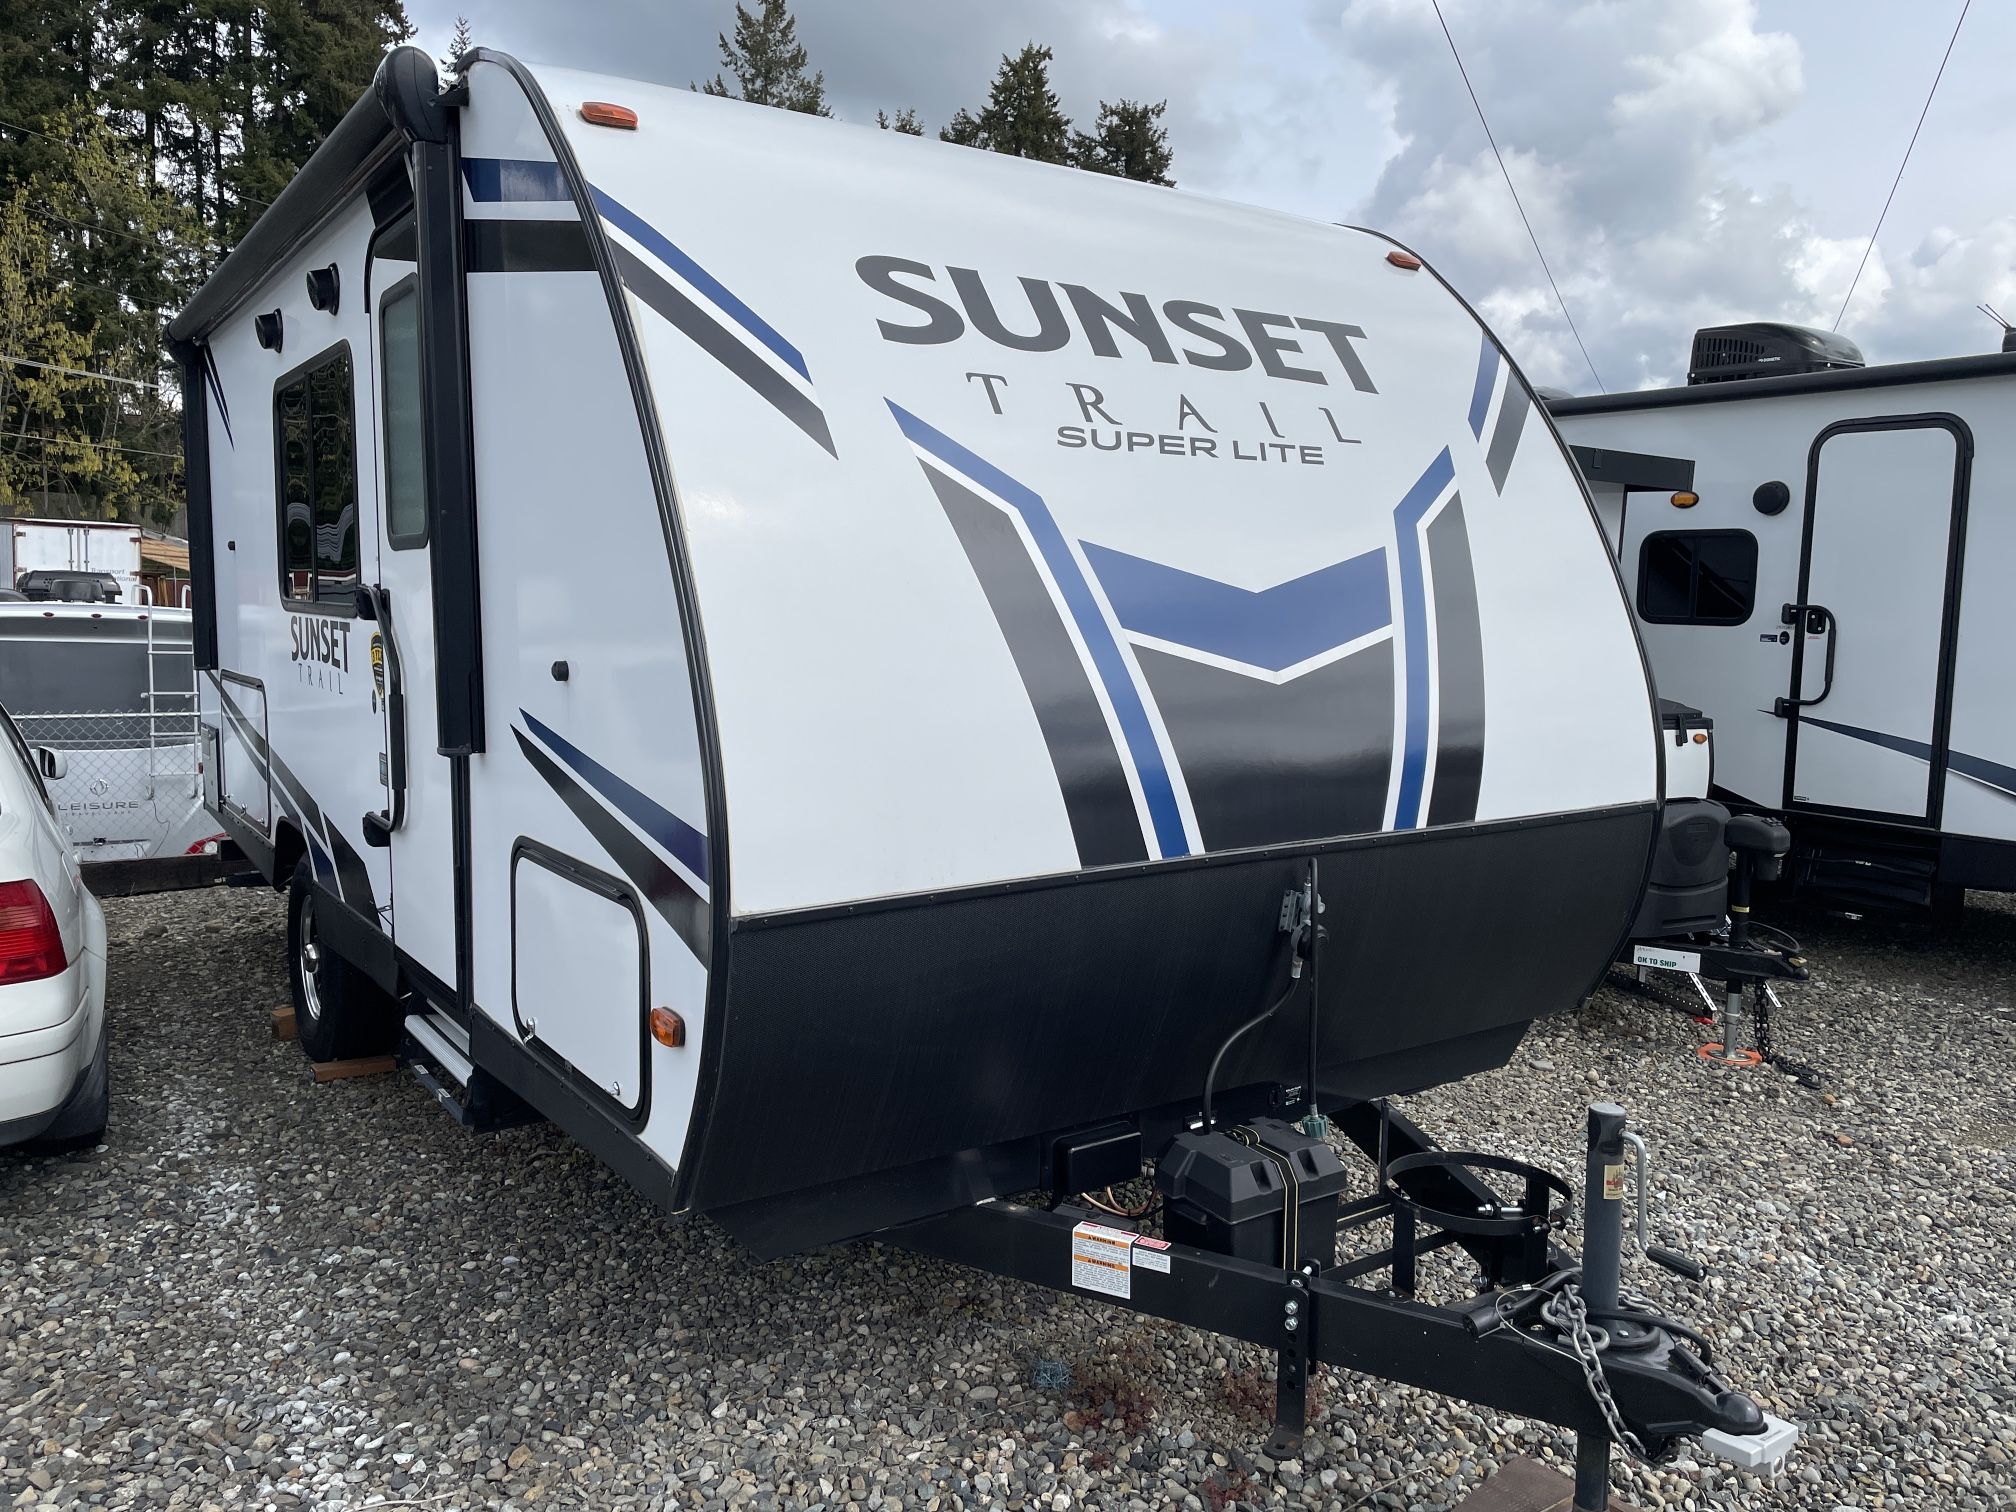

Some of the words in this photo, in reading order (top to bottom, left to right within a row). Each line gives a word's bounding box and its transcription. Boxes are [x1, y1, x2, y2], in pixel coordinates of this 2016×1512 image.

[855, 255, 1379, 394] SUNSET
[966, 372, 1361, 444] TRAIL
[1057, 426, 1219, 458] SUPER
[1232, 440, 1324, 465] LITE
[290, 615, 350, 674] SUNSET
[298, 663, 343, 695] TRAIL
[58, 801, 139, 811] LEISURE
[1637, 956, 1648, 964] OK
[1649, 957, 1658, 965] TO
